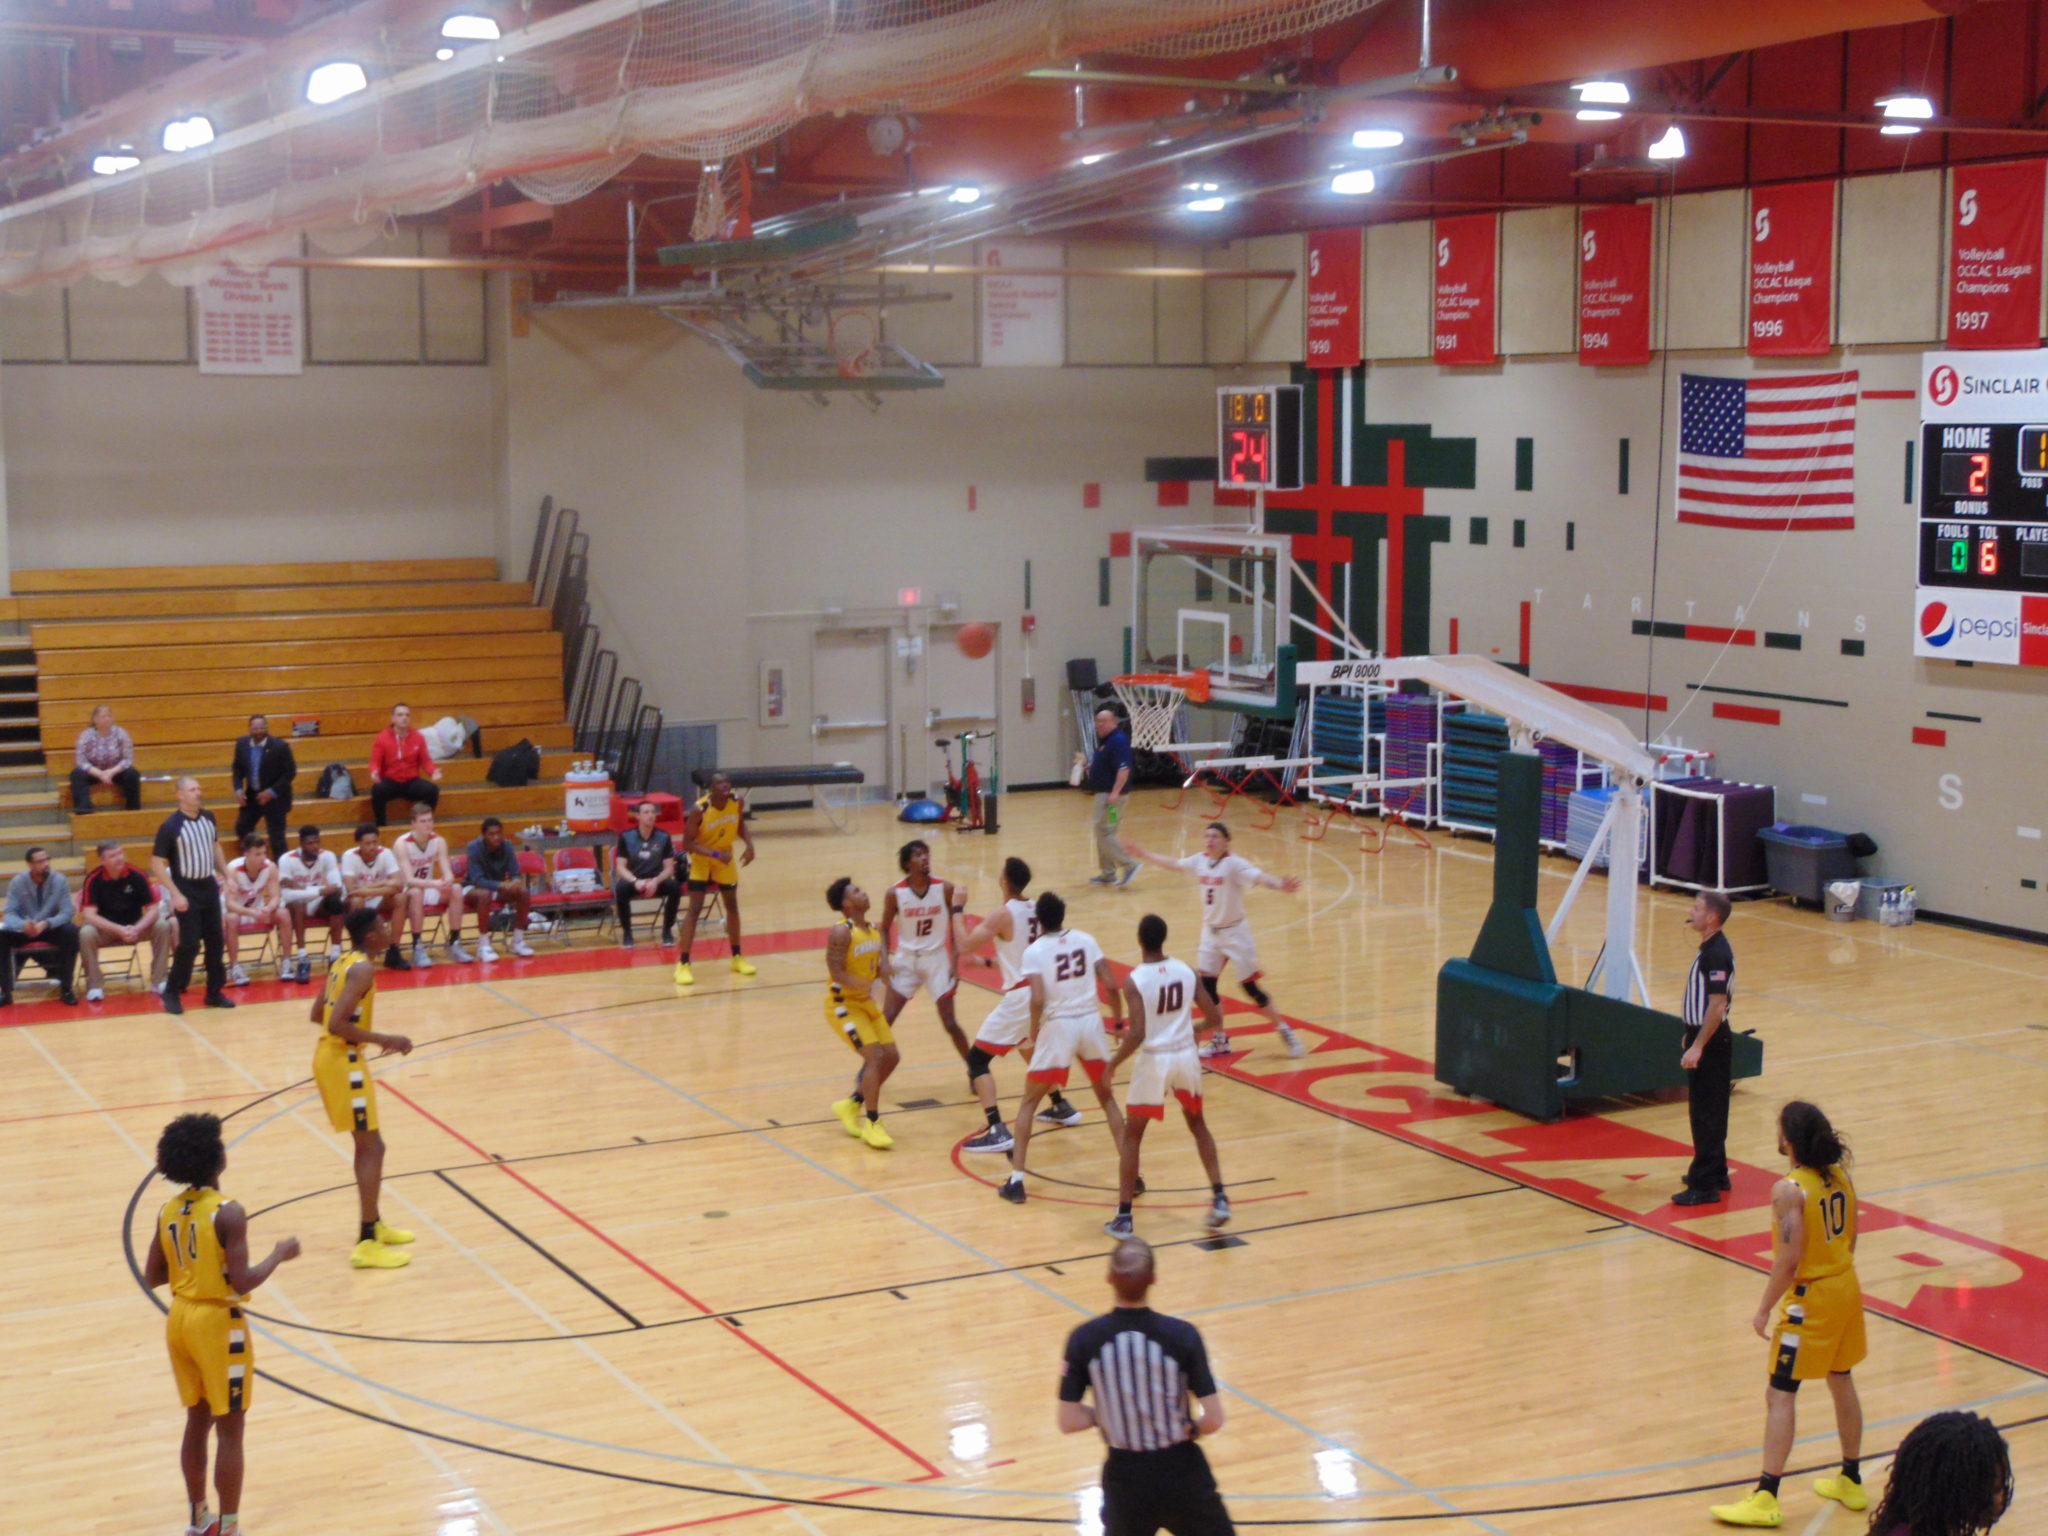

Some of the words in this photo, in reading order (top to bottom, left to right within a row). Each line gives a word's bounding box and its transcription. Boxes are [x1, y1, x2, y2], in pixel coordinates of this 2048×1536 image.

[1959, 248, 2004, 263] Volleyball
[1754, 259, 1794, 276] Volleyball
[1957, 264, 1992, 278] OCCAC
[1997, 264, 2032, 279] League
[1784, 276, 1812, 290] League
[1956, 280, 2010, 297] Champions
[1754, 291, 1799, 306] Champions
[1752, 320, 1783, 338] 1996
[1955, 311, 1988, 330] 1997
[1308, 339, 1331, 355] 1990
[1436, 334, 1458, 350] 1991
[1582, 333, 1608, 349] 1994
[1963, 376, 2040, 395] SINCLAIR
[1943, 427, 1990, 449] HOME
[1231, 431, 1267, 483] 24
[1968, 455, 1989, 494] 2
[2021, 476, 2043, 489] POSS
[1954, 499, 1989, 516] BONUS
[1937, 524, 1970, 539] FOULS
[1979, 525, 1998, 540] TOL
[1951, 541, 1967, 571] 0
[1980, 541, 1997, 574] 6
[1959, 616, 2018, 641] pepsi
[1331, 665, 1353, 679] BPI
[1354, 664, 1381, 678] 8000
[1938, 773, 1964, 811] S
[916, 918, 933, 937] 12
[1056, 948, 1086, 982] 23
[1157, 980, 1183, 1015] 10
[1819, 1190, 1846, 1241] 10
[168, 1221, 198, 1269] 14
